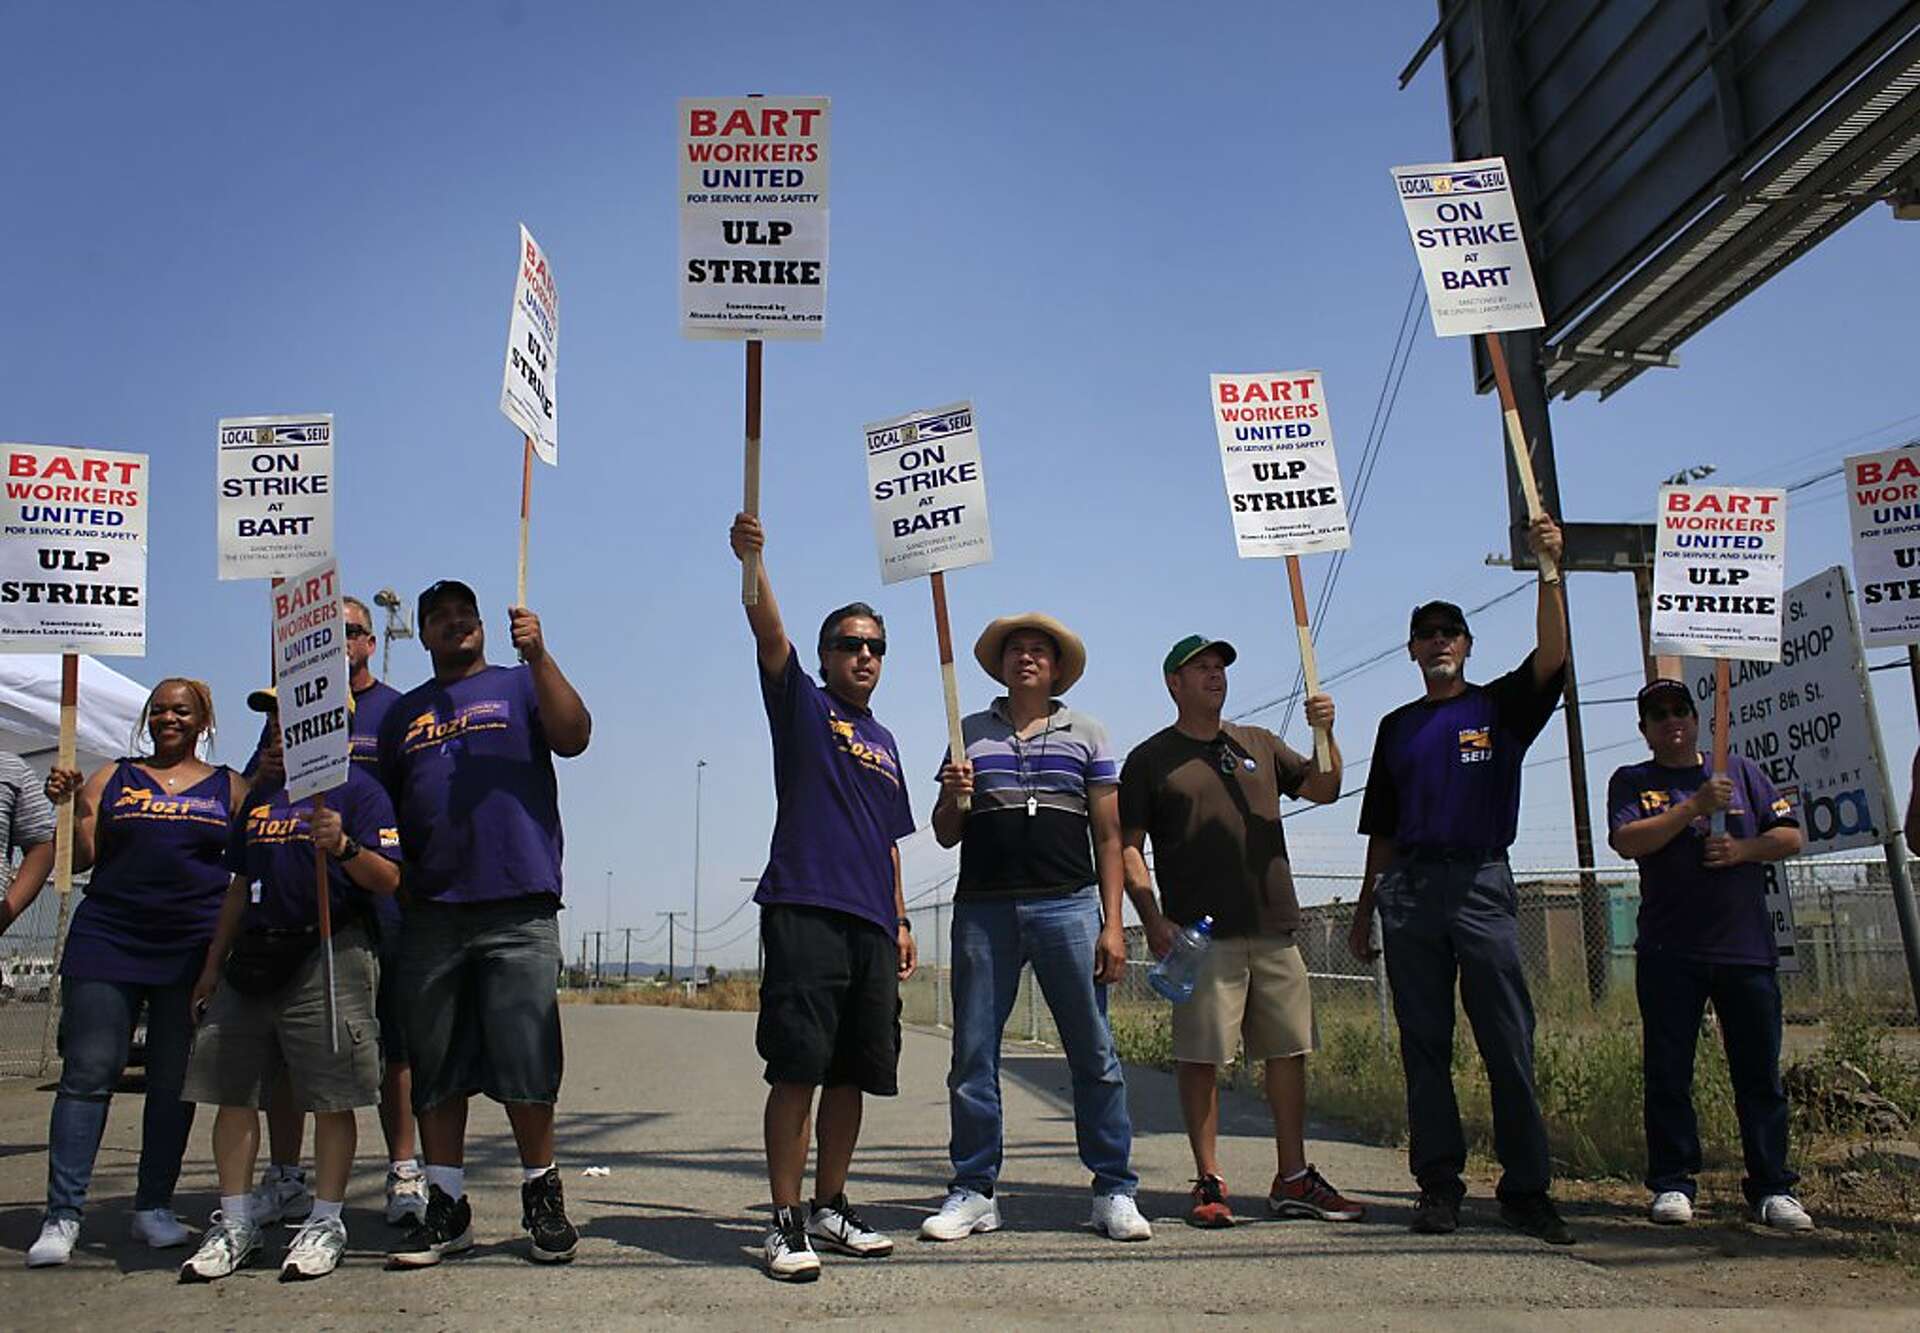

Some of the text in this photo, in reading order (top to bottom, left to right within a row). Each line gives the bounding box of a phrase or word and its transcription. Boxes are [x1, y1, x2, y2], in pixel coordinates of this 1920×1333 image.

[690, 109, 821, 137] BART
[688, 143, 818, 163] WORKERS
[702, 169, 805, 188] UNITED
[1400, 172, 1505, 194] LOCAL SEIU
[687, 194, 818, 203] FOR SERVICE AND SAFETY
[1437, 201, 1483, 223] ON
[722, 220, 793, 245] ULP
[1417, 222, 1519, 248] STRIKE
[1464, 253, 1479, 263] AT
[688, 259, 821, 285] STRIKE
[1442, 266, 1511, 290] BART
[1219, 379, 1315, 403] BART
[1221, 403, 1319, 422] WORKERS
[222, 427, 329, 444] LOCAL SEIU
[868, 413, 972, 450] LOCAL SEIU
[1236, 423, 1311, 441] UNITED
[8, 454, 140, 484] BART
[252, 453, 299, 473] ON
[899, 445, 945, 471] ON
[874, 462, 977, 500] STRIKE
[1252, 461, 1307, 482] ULP
[1856, 457, 1920, 486] BA
[6, 483, 138, 506] WORKERS
[222, 475, 328, 497] STRIKE
[1856, 484, 1918, 506] WOR
[267, 502, 285, 512] AT
[919, 496, 935, 507] AT
[1233, 486, 1337, 512] STRIKE
[1668, 493, 1779, 514] BART
[21, 506, 124, 525] UNITED
[239, 517, 314, 536] BART
[893, 505, 966, 537] BART
[1665, 516, 1776, 532] WORKERS
[5, 526, 139, 540] FOR SERVICE AND SAFETY
[1676, 534, 1764, 549] UNITED
[38, 549, 110, 571] ULP
[1688, 567, 1749, 586] ULP
[1, 582, 139, 606] STRIKE
[276, 570, 335, 620] BART
[1657, 594, 1775, 615] STRIKE
[278, 601, 338, 643] WORKERS
[1790, 600, 1807, 622] St.
[284, 628, 332, 662] UNITED
[1697, 625, 1834, 701] OALAND SHOP
[293, 676, 328, 708] ULP
[1740, 698, 1772, 724] EAST
[1779, 690, 1800, 711] 8th
[1805, 681, 1824, 702] St.
[285, 706, 345, 750] STRIKE
[1788, 712, 1841, 751] SHOP
[140, 800, 192, 814] 1021
[257, 818, 298, 835] 1021
